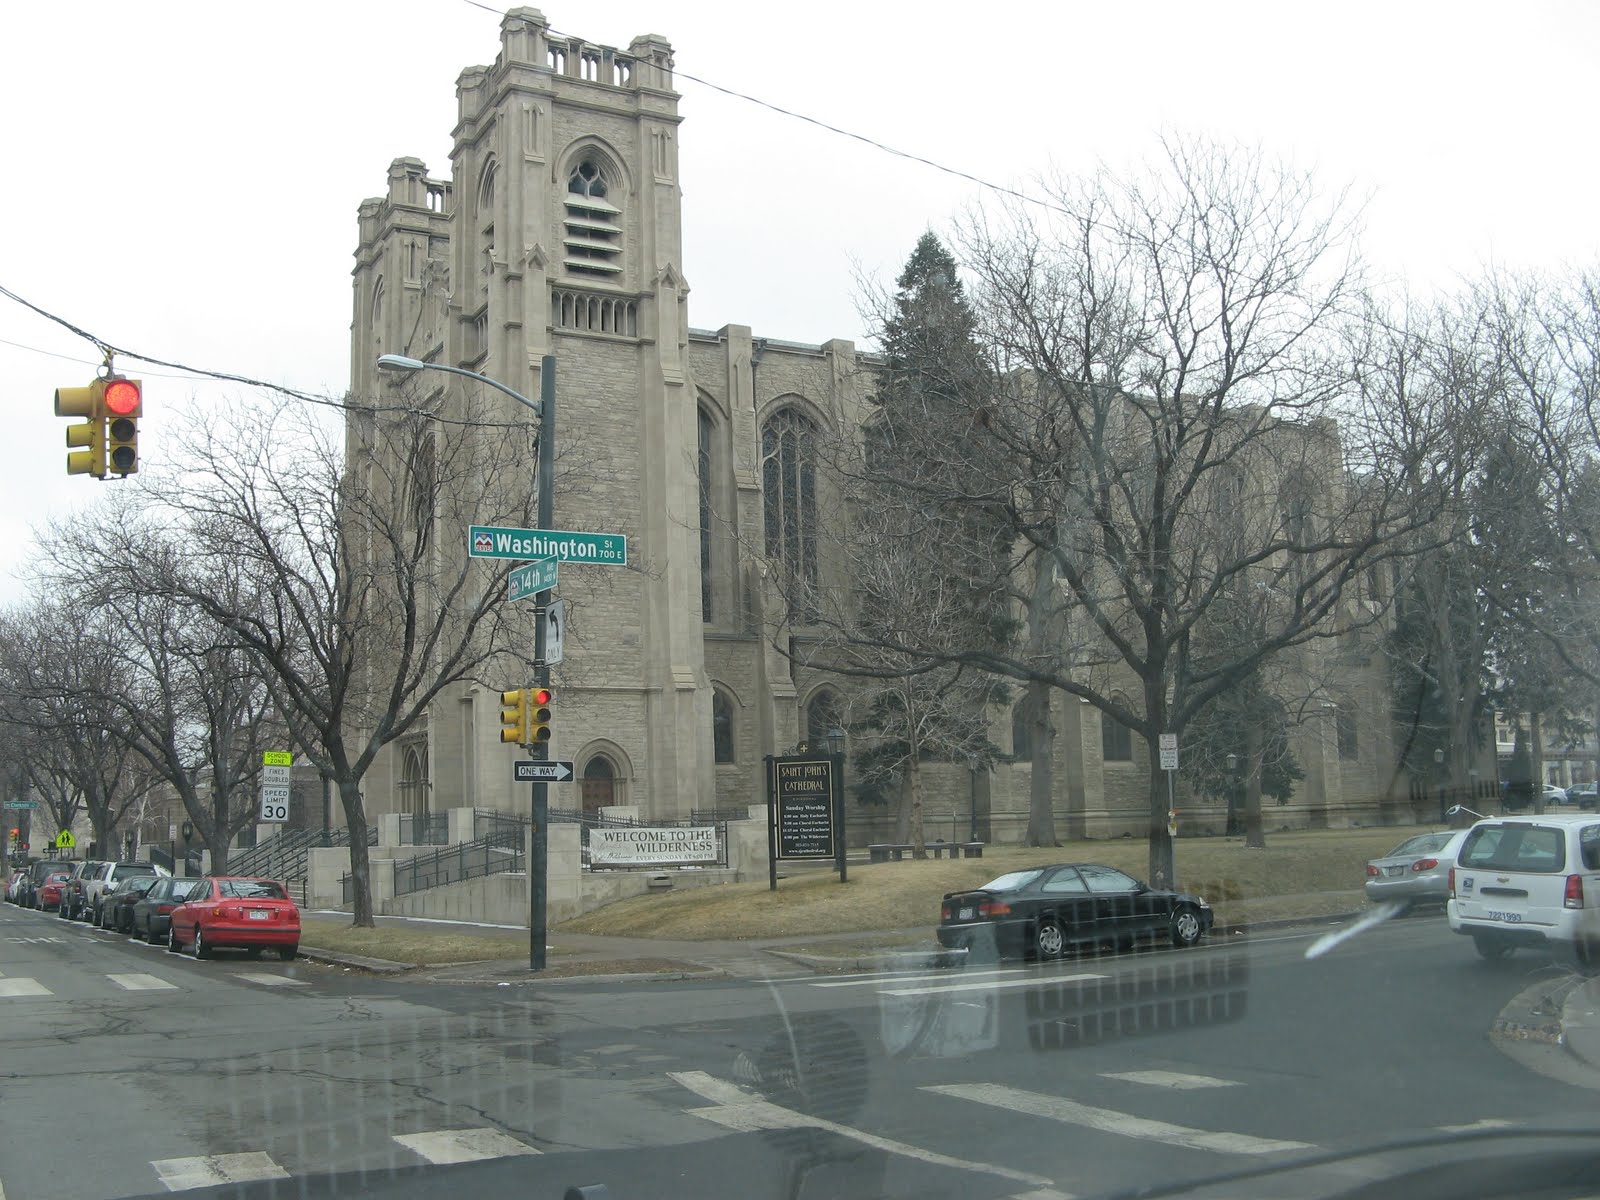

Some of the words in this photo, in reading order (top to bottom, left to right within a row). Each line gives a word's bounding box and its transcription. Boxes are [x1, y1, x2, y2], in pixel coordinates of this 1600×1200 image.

[496, 533, 597, 560] Washington
[604, 540, 613, 548] St
[599, 550, 615, 559] 700
[617, 551, 622, 559] E
[521, 569, 540, 591] 14th
[547, 645, 561, 661] ONLY
[520, 767, 537, 776] ONE
[539, 767, 556, 776] WAY
[781, 767, 802, 777] SAINT
[804, 765, 827, 778] JOHN'S
[784, 780, 824, 791] CATHEDRAL
[264, 805, 286, 819] 30
[604, 831, 667, 842] WELCOME
[668, 831, 685, 841] TO
[688, 830, 712, 840] THE
[635, 841, 713, 853] WILDERNESS
[1488, 911, 1521, 921] 7221993
